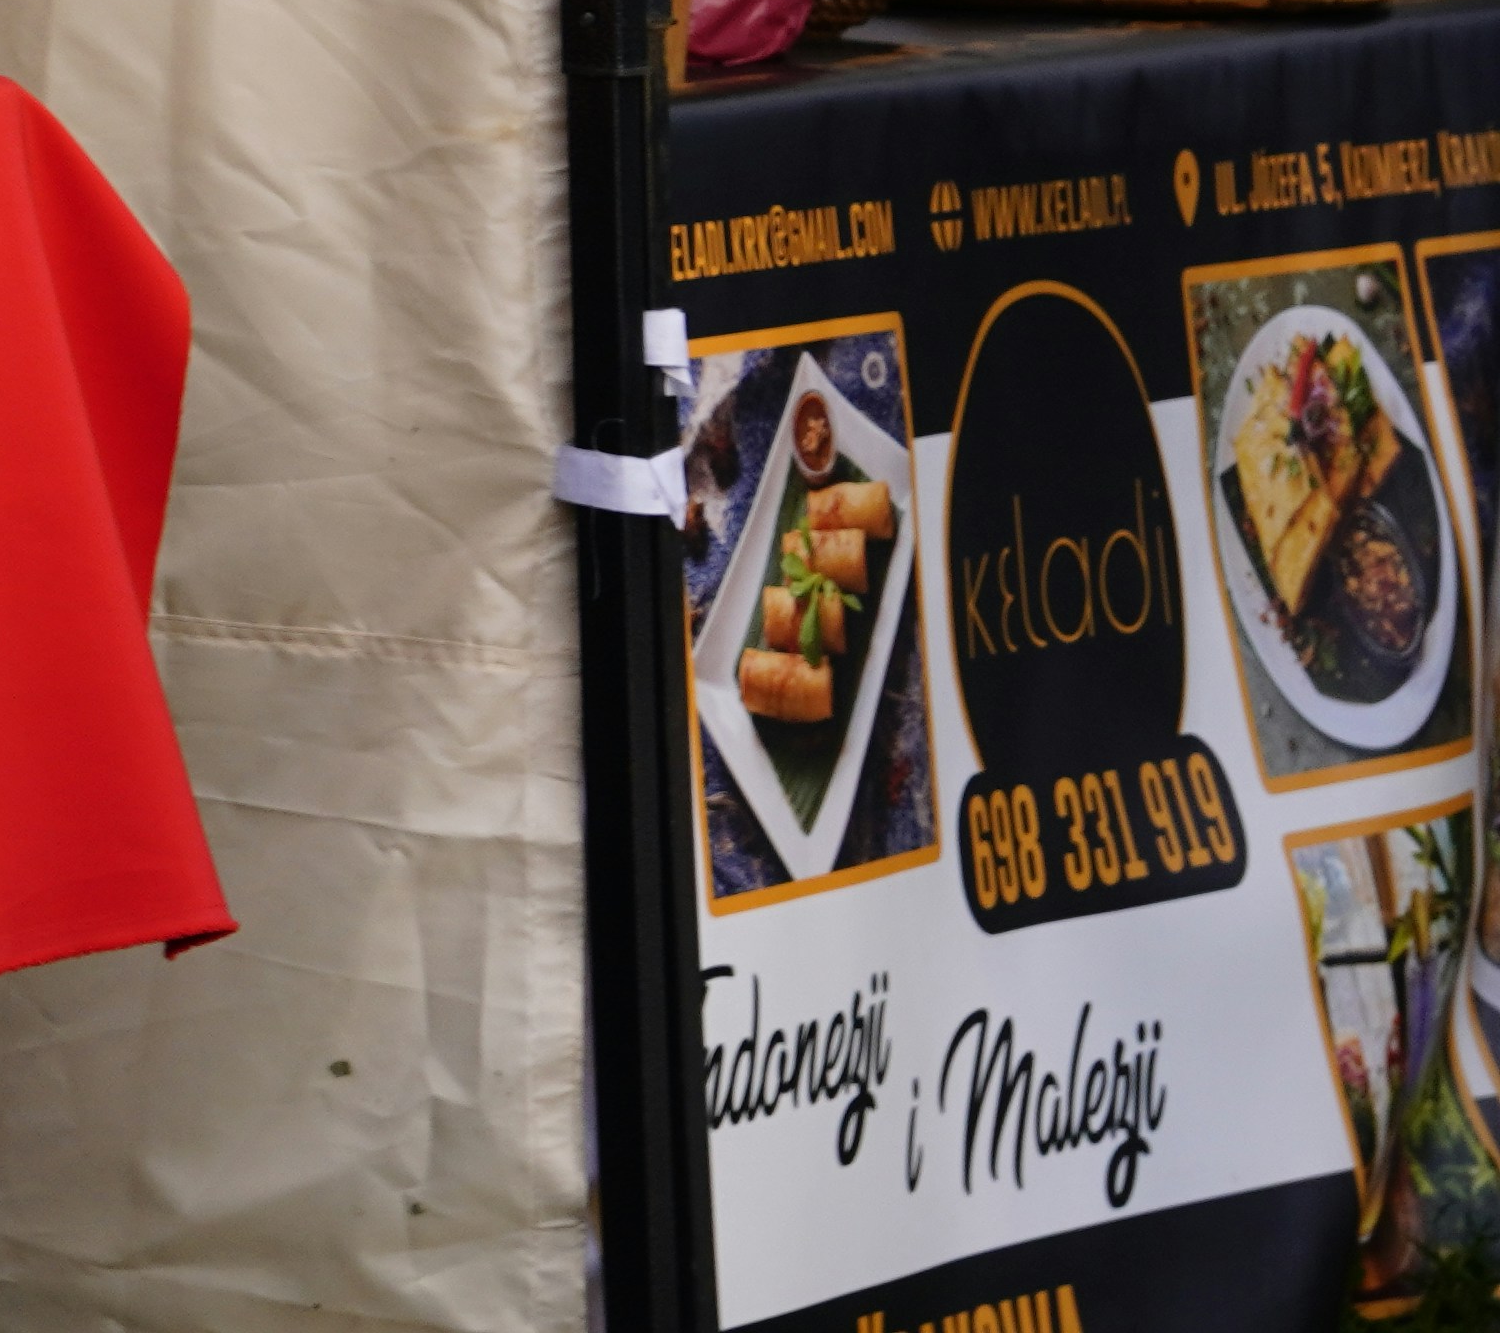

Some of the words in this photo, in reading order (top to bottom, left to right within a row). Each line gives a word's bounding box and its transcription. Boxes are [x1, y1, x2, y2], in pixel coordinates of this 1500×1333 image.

[968, 783, 1049, 910] 698
[1054, 771, 1149, 893] 331
[1143, 753, 1239, 880] 919
[939, 1001, 1167, 1208] Malezji
